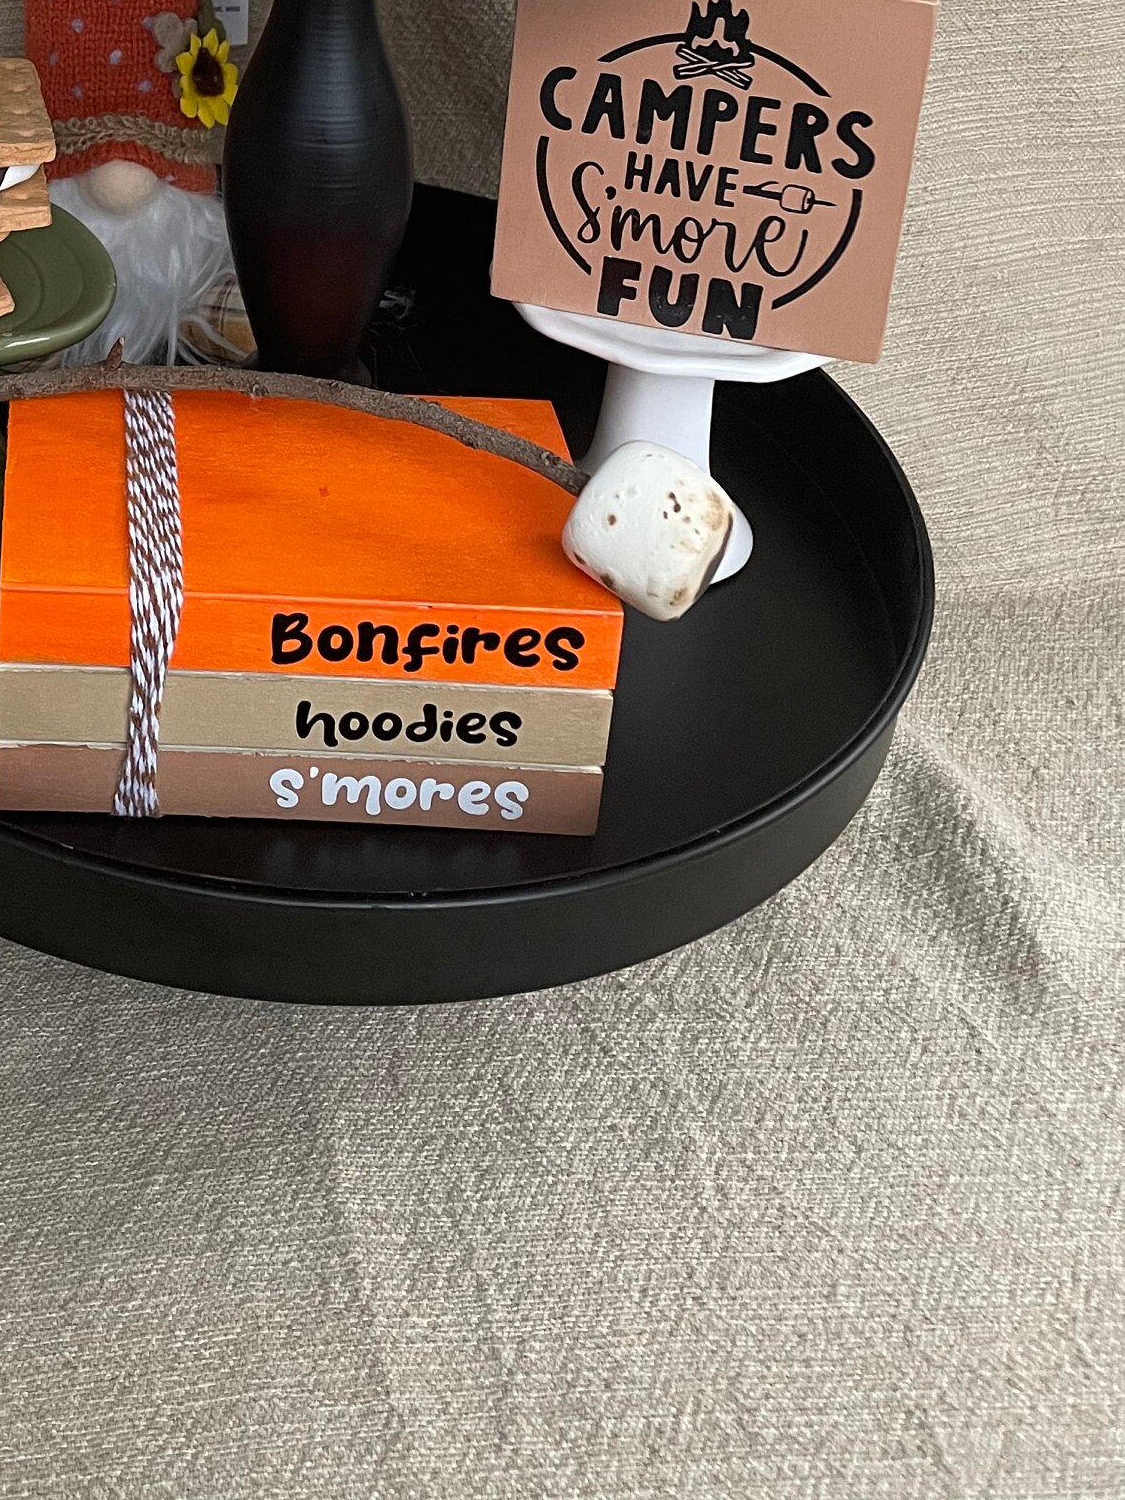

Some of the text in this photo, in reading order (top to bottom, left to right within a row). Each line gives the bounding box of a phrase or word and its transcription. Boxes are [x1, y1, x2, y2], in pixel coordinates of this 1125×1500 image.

[539, 66, 876, 179] CAMPERS
[624, 151, 739, 208] HAVE
[596, 256, 764, 341] FUN
[271, 612, 585, 672] Bonfires
[295, 700, 522, 747] hoodies
